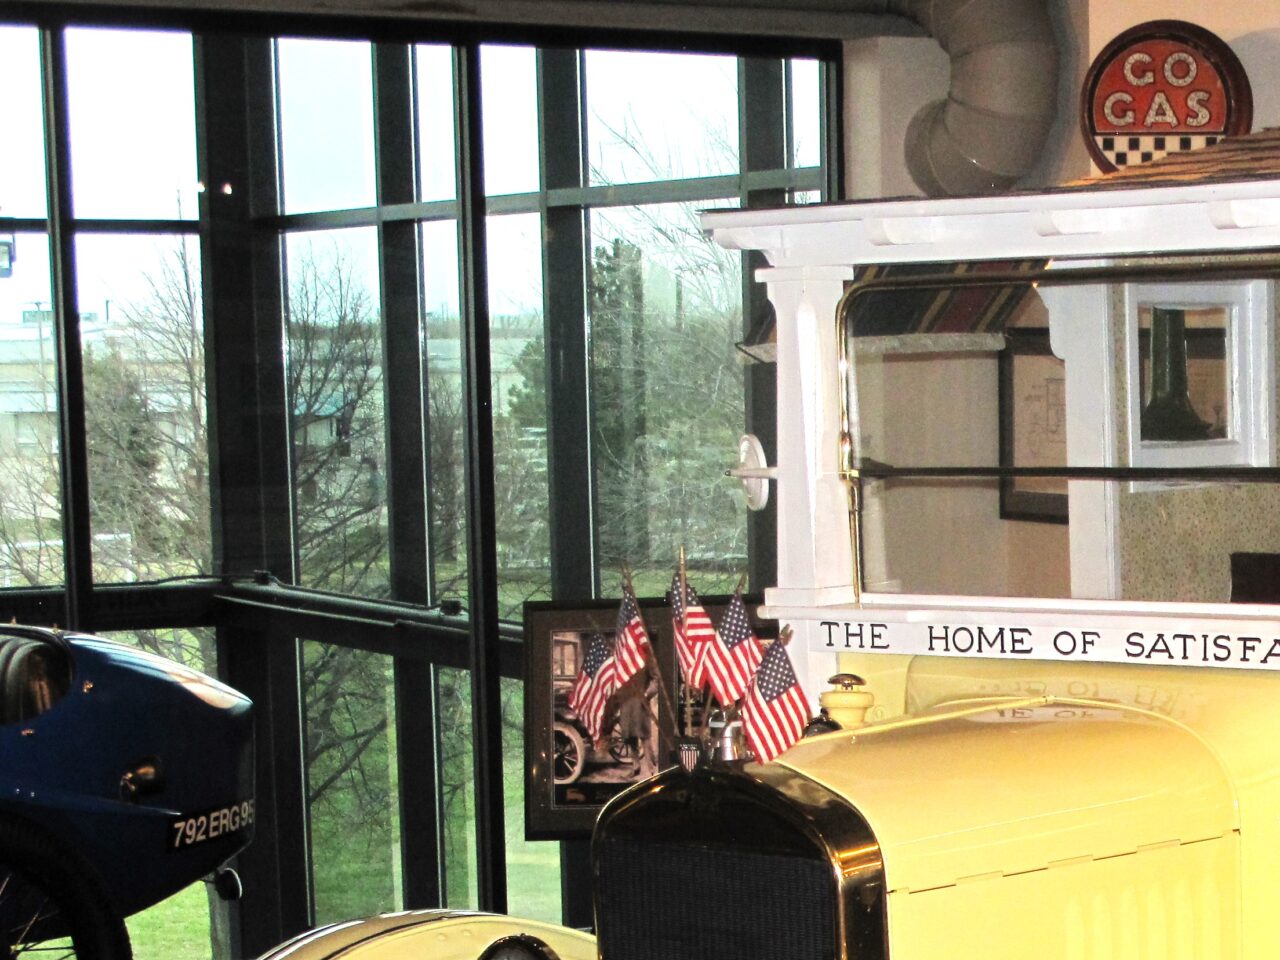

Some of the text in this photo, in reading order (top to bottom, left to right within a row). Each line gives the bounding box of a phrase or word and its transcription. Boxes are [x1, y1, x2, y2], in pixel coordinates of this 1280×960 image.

[1123, 52, 1198, 87] GO
[1103, 90, 1211, 128] GAS
[819, 621, 890, 649] THE
[927, 625, 1033, 654] HOME
[1053, 630, 1101, 656] OF
